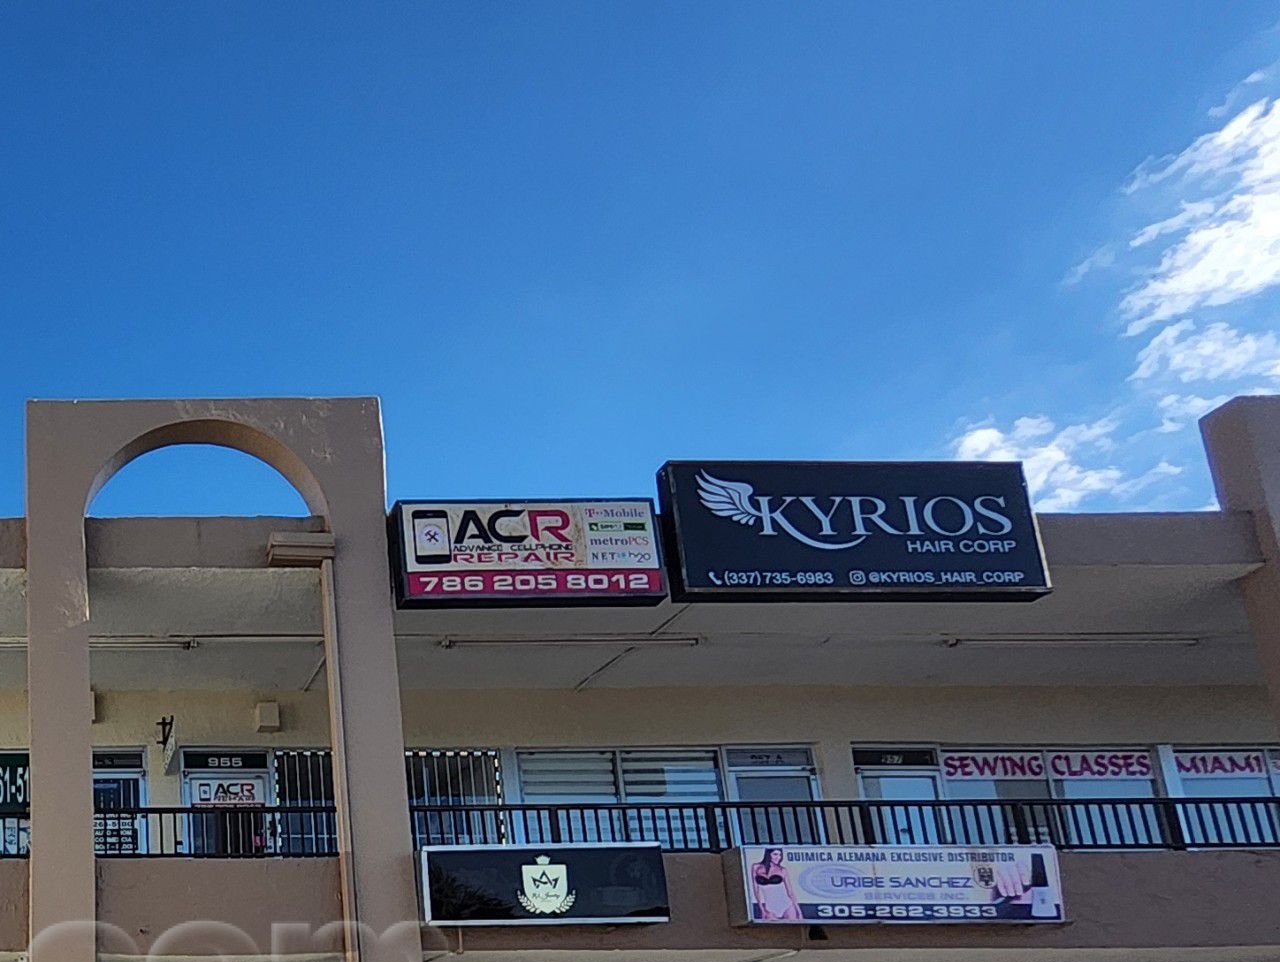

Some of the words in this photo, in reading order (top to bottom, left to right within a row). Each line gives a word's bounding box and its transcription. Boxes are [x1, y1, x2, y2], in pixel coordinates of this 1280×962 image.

[754, 495, 1014, 544] KYRIOS
[453, 509, 571, 544] ACR
[590, 536, 650, 546] metroPCS
[907, 540, 954, 553] HAIR
[959, 540, 1017, 553] CORP
[453, 543, 503, 553] ADVANCE
[453, 551, 575, 564] REPAIR
[419, 576, 483, 592] 786
[493, 574, 557, 591] 205
[566, 573, 649, 590] 8012
[724, 571, 835, 586] (337)735-6983
[868, 571, 1025, 585] @KYRIOS_HAIR_CORP
[207, 757, 243, 767] 955
[943, 755, 1043, 778] SEWING
[1051, 754, 1152, 778] CLASSES
[1175, 754, 1264, 775] MIAMI
[214, 783, 256, 798] ACR
[786, 852, 834, 862] QUIMICA
[836, 852, 888, 863] ALEMANA
[890, 852, 945, 863] EXCLUSIVE
[948, 852, 1016, 863] DISTRIBUTOR
[830, 876, 885, 889] URIBE
[889, 876, 975, 889] SANCHEZ
[863, 892, 935, 902] SERVICES
[939, 892, 969, 902] INC.
[817, 905, 998, 918] 305-262-3933
